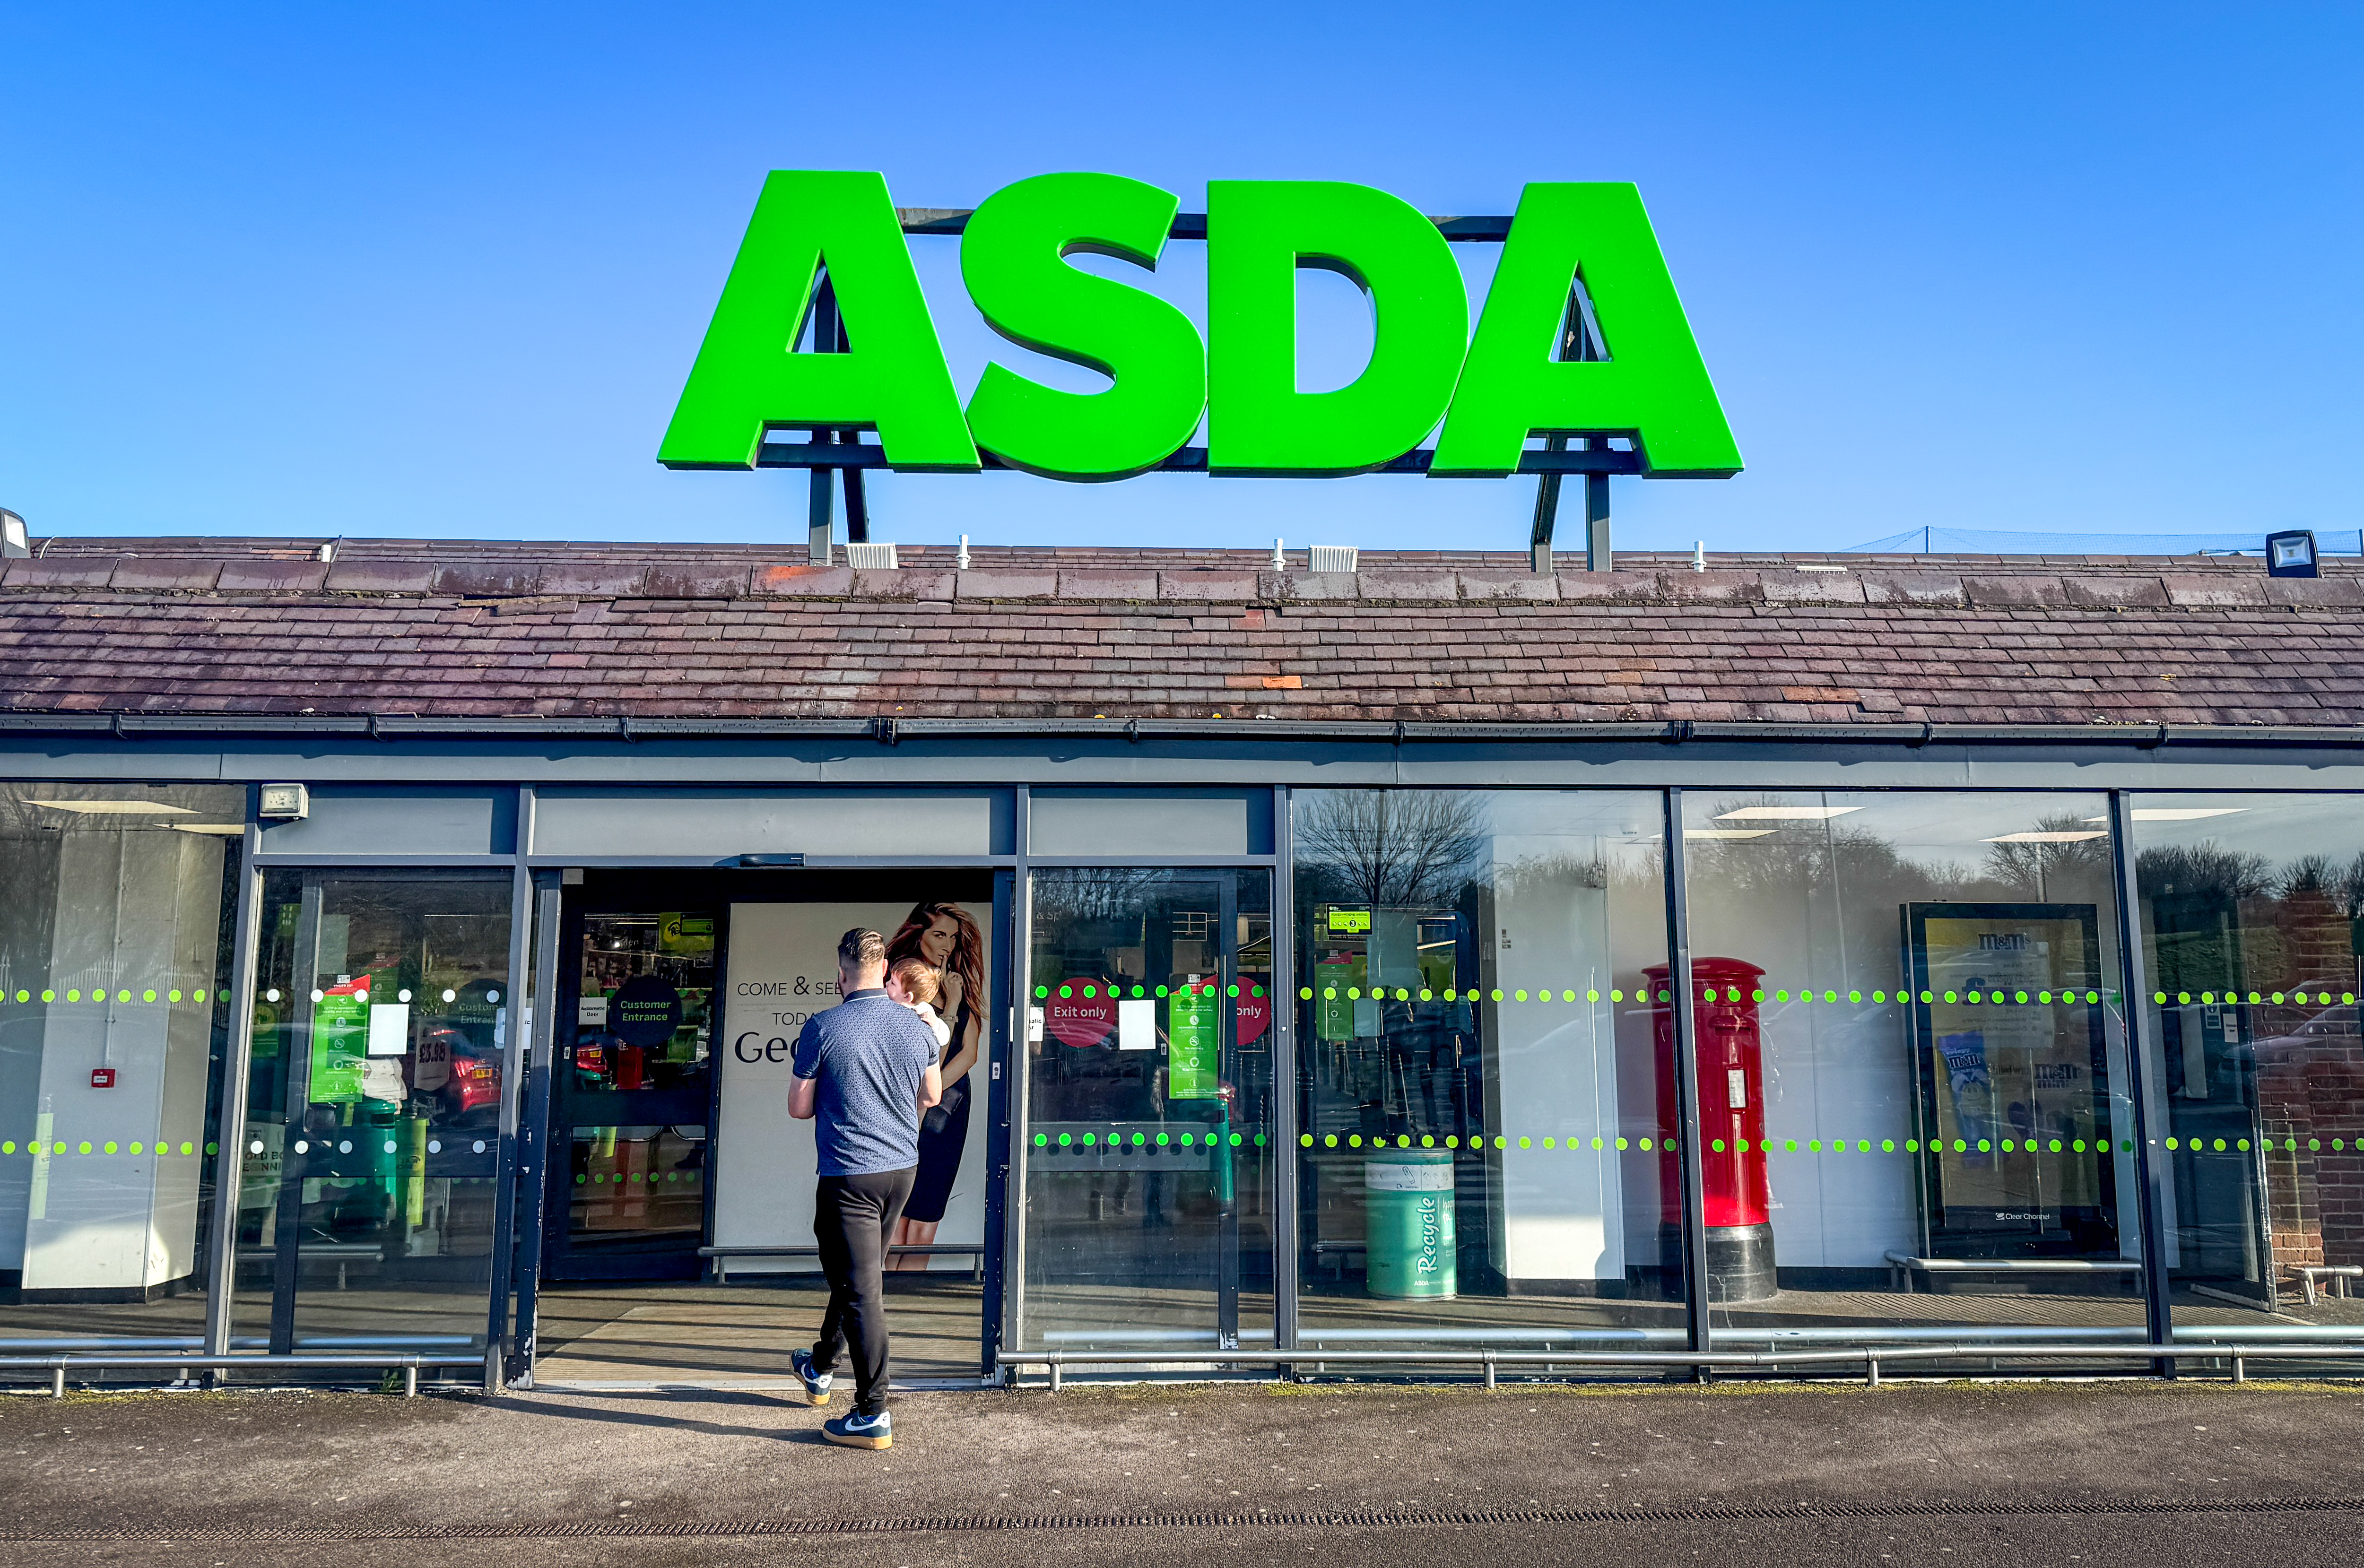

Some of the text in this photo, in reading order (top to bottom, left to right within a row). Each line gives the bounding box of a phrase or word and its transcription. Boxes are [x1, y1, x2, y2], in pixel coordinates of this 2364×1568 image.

[657, 171, 1745, 482] ASDA
[738, 983, 787, 996] COME
[794, 976, 810, 995] &
[620, 1001, 671, 1009] Customer
[622, 1013, 668, 1021] Entrance
[772, 1013, 814, 1025] TOD
[1054, 1006, 1107, 1019] Exit only
[1417, 1197, 1440, 1274] Recycle
